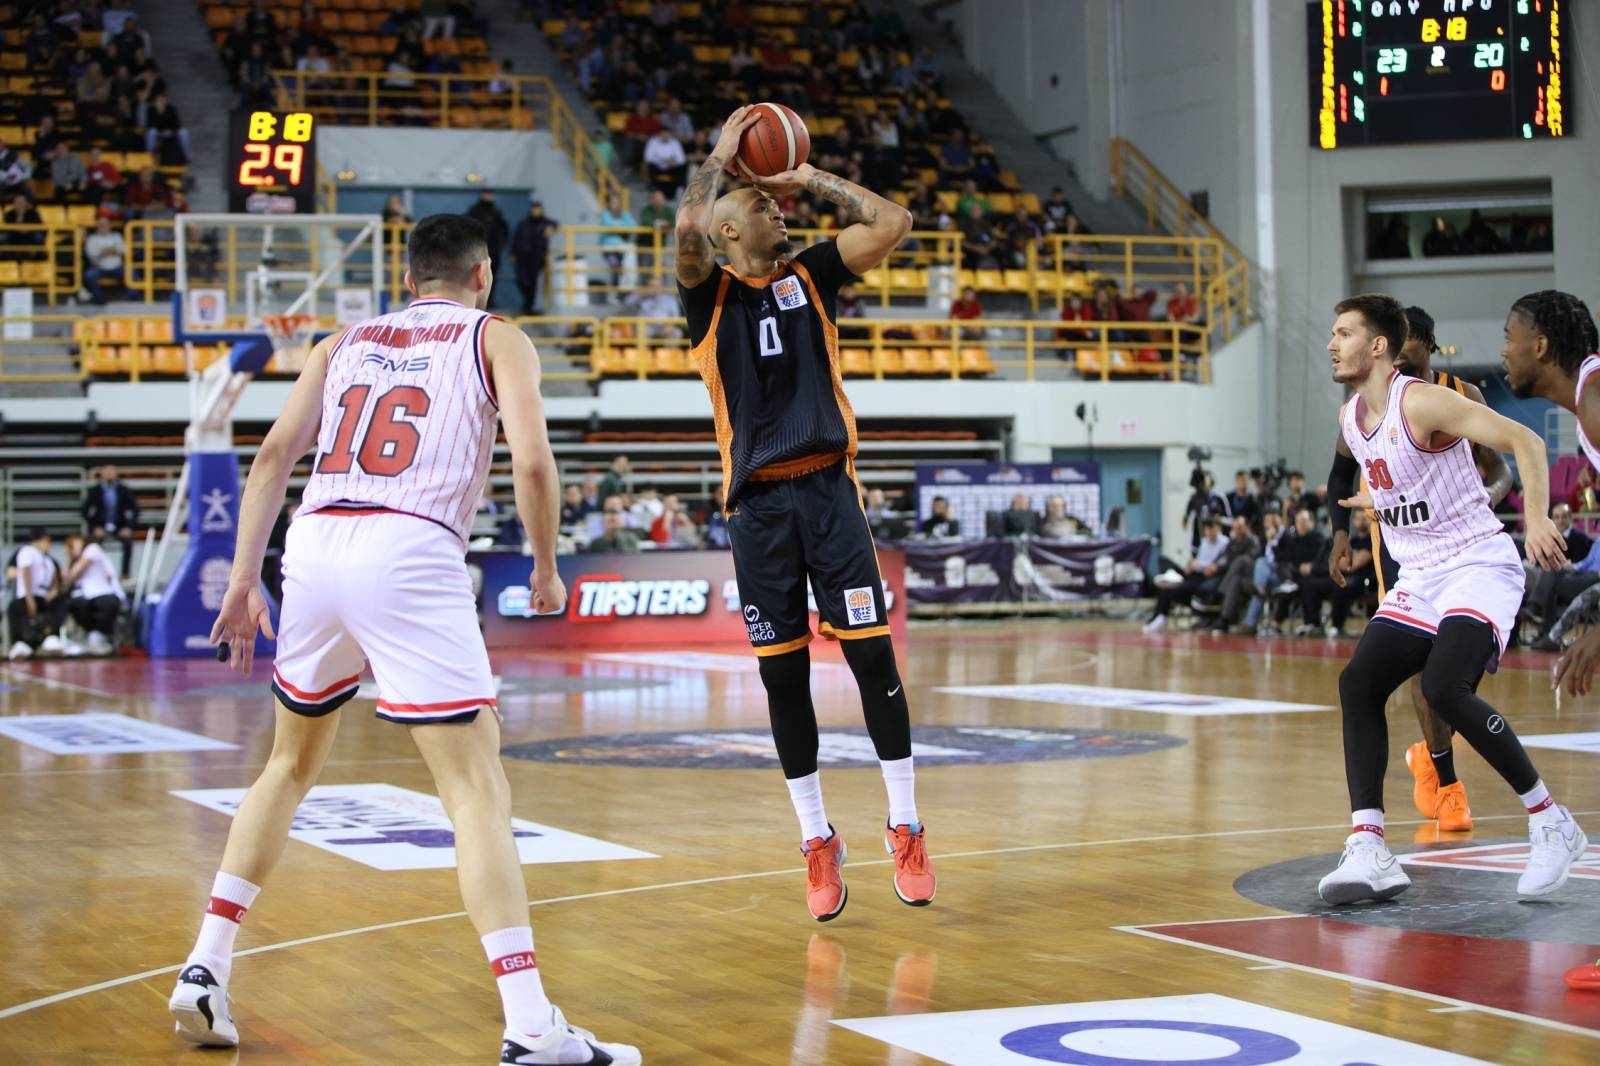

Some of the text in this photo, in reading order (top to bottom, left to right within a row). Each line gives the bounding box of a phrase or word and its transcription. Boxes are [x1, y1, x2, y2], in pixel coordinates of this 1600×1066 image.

[1377, 48, 1408, 74] 23
[1474, 43, 1504, 68] 20
[1491, 69, 1505, 91] 0
[759, 316, 783, 357] 0
[315, 384, 431, 477] 16
[1365, 458, 1393, 490] 30
[1374, 494, 1430, 527] win
[578, 580, 710, 617] TIPSTERS
[501, 955, 535, 971] GSA
